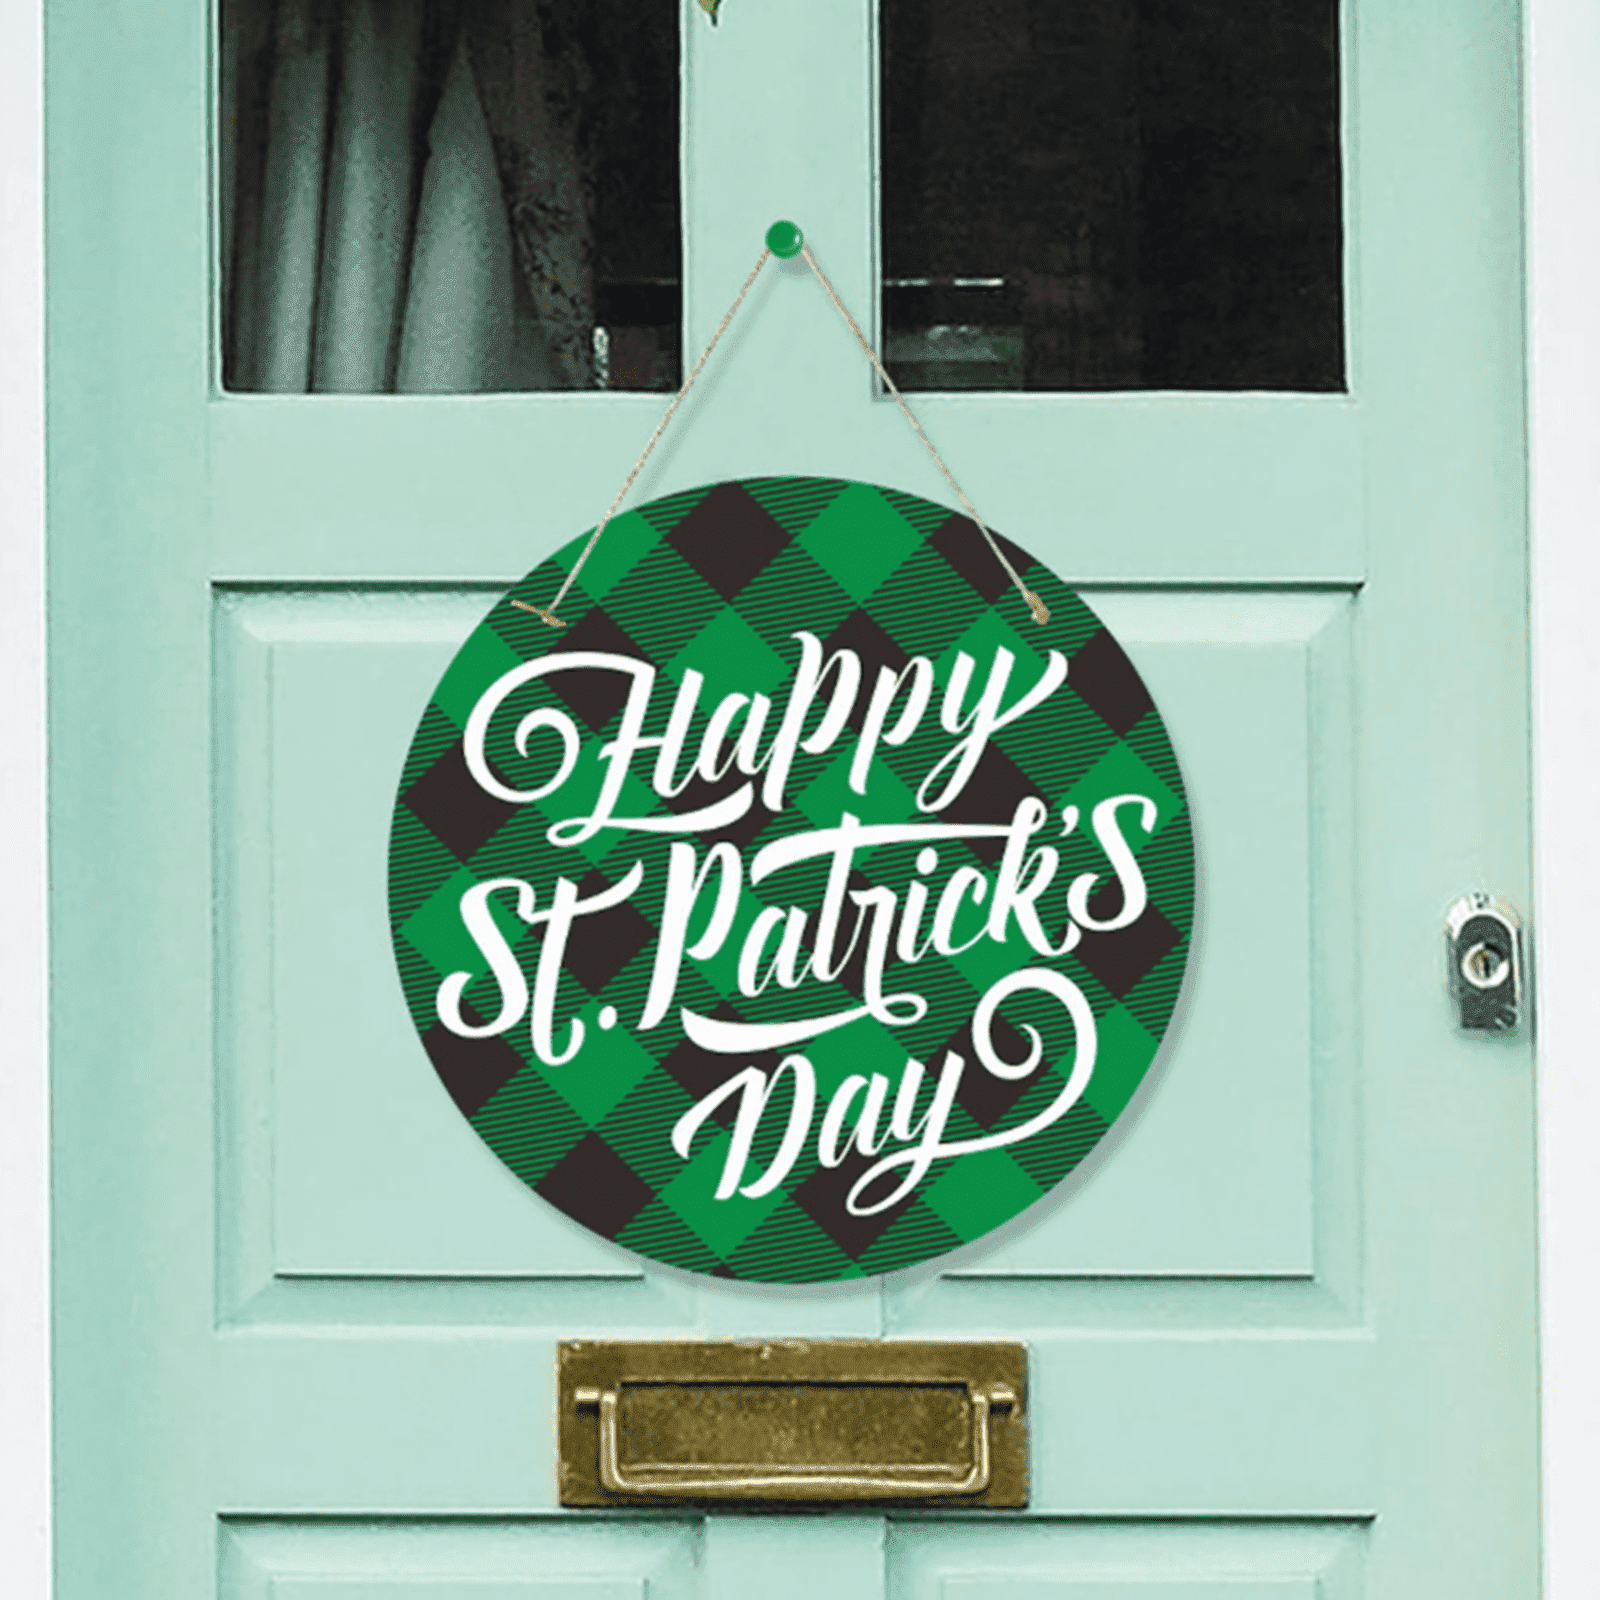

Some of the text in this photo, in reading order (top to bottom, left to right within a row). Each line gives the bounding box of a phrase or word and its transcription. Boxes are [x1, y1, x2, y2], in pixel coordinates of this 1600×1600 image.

[464, 631, 1068, 847] Happy
[436, 860, 643, 1066] St.
[671, 968, 1097, 1216] Day
